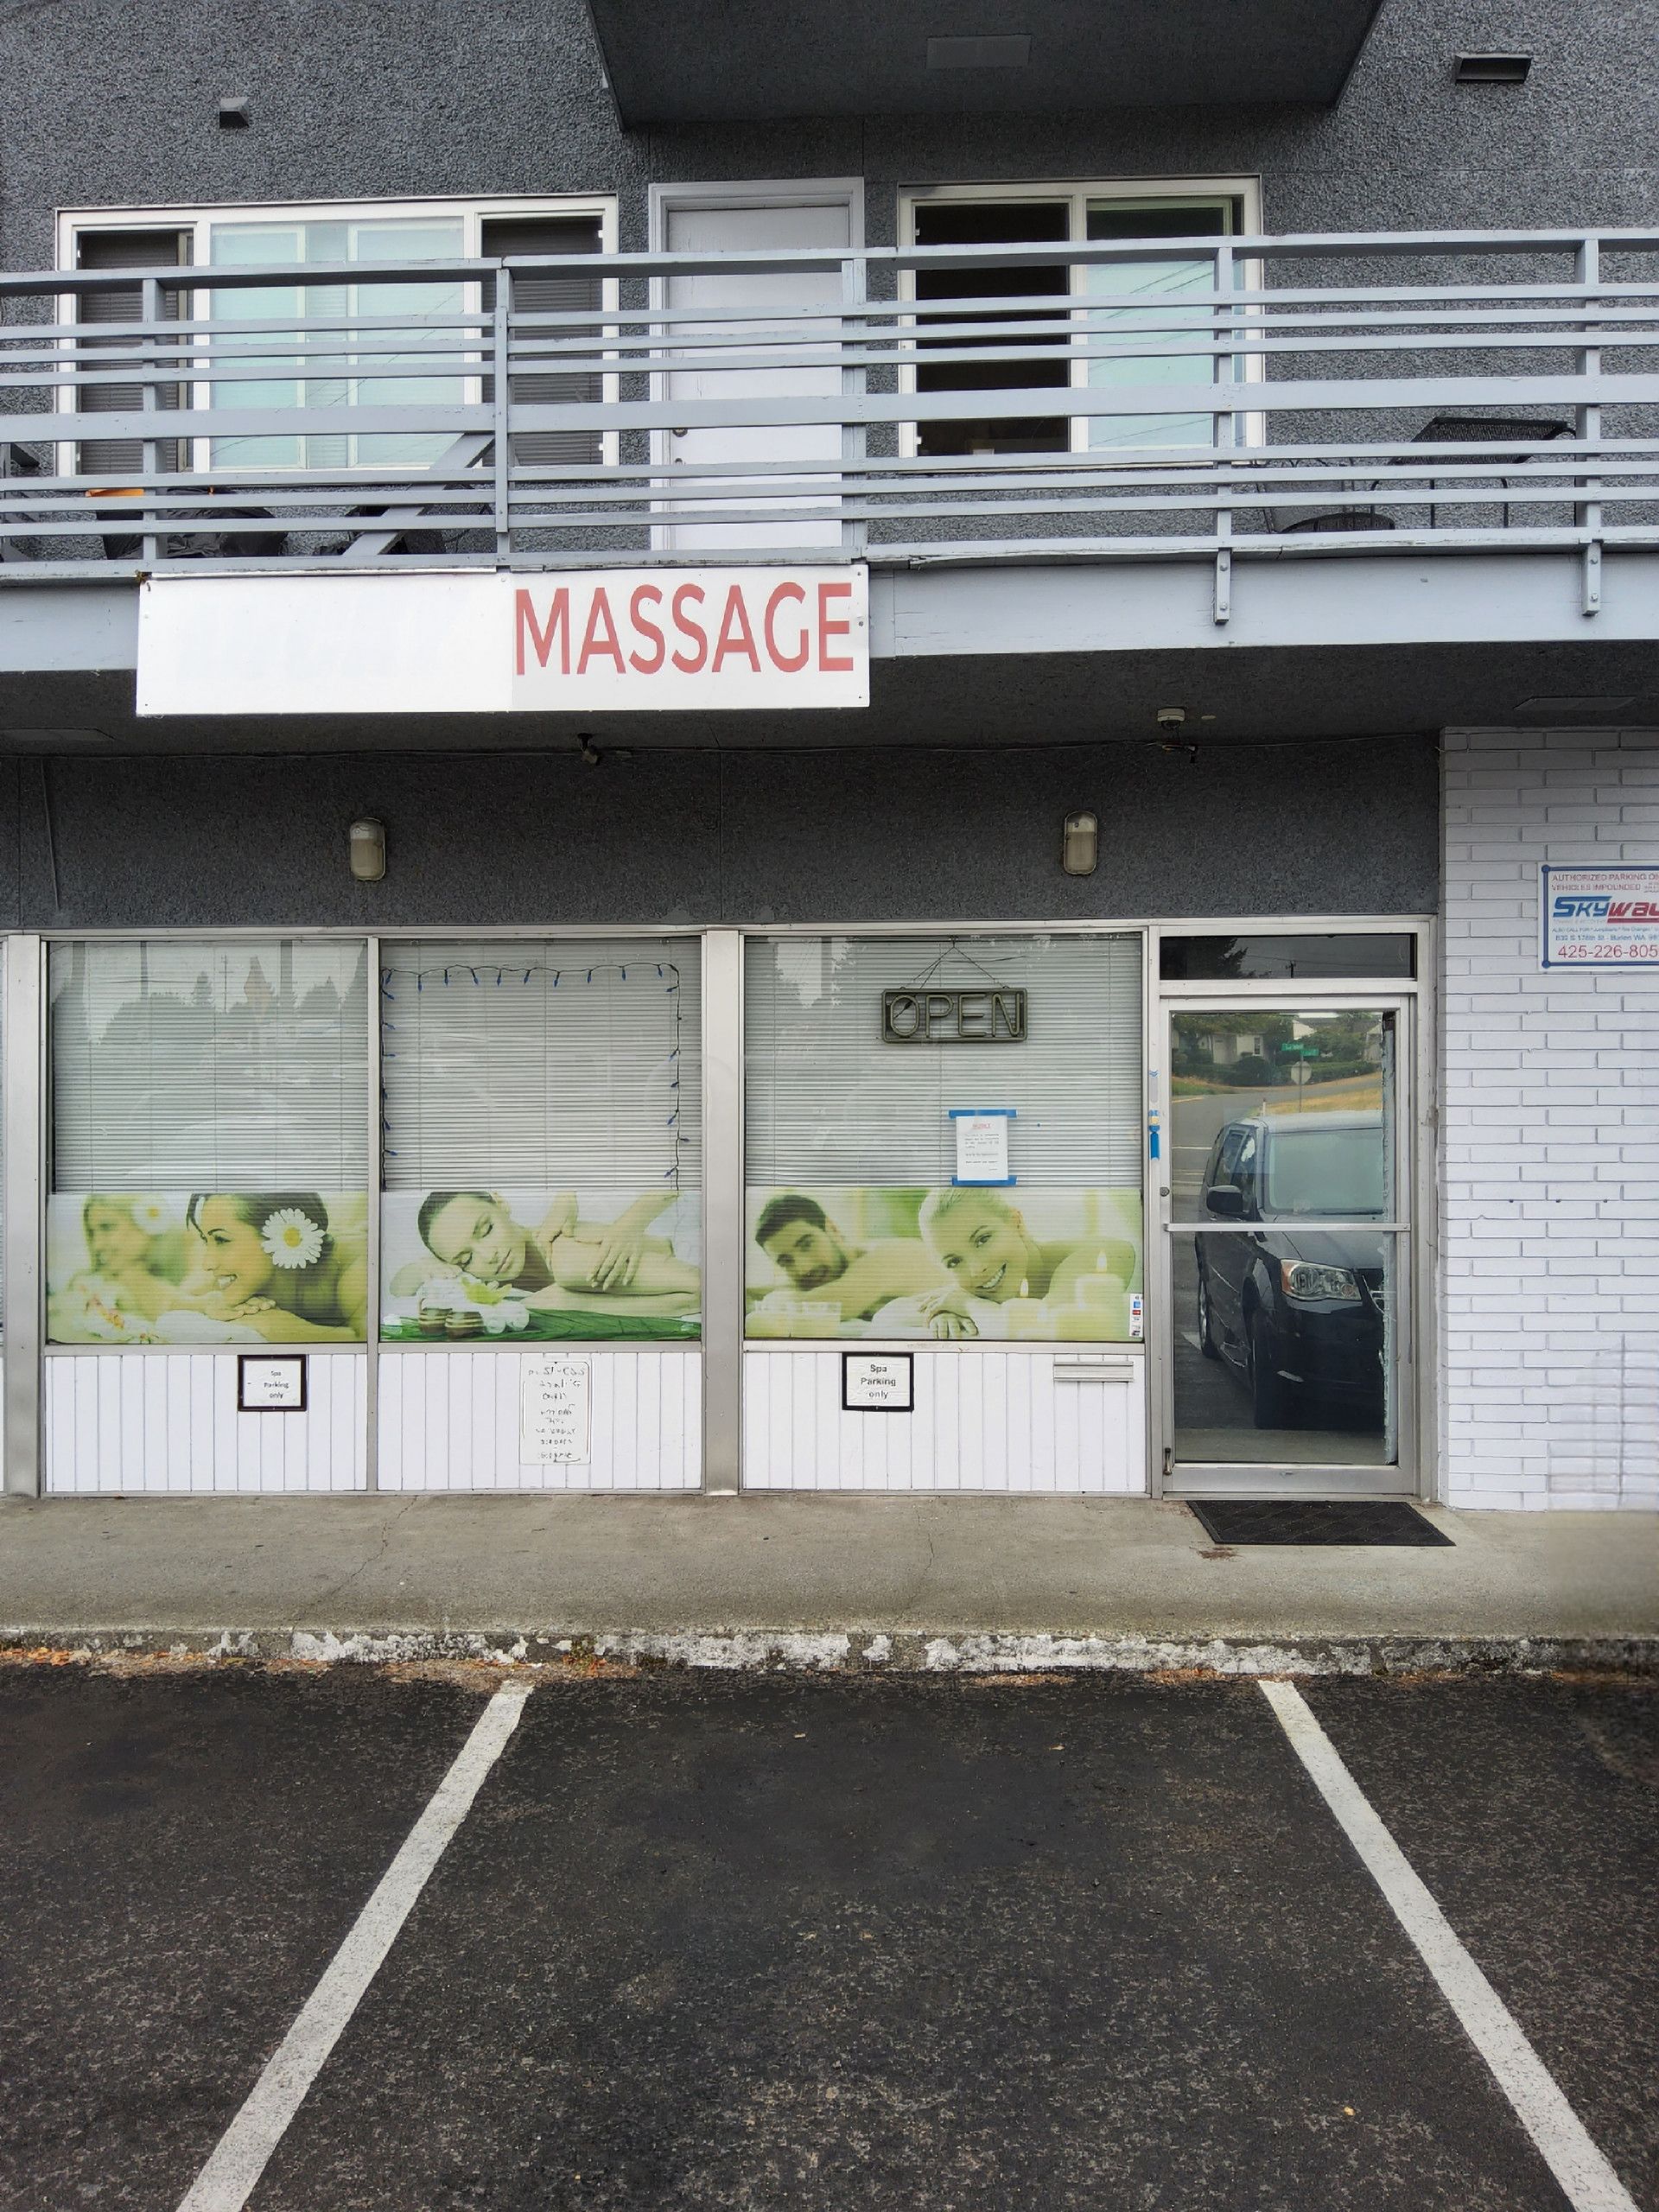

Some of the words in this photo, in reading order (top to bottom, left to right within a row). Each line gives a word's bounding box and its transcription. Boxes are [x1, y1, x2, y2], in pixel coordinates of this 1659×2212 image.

[515, 582, 855, 677] MASSAGE
[890, 993, 1020, 1038] OPEN
[870, 1364, 887, 1373] Spa
[861, 1377, 896, 1387] Parking
[868, 1390, 888, 1399] only
